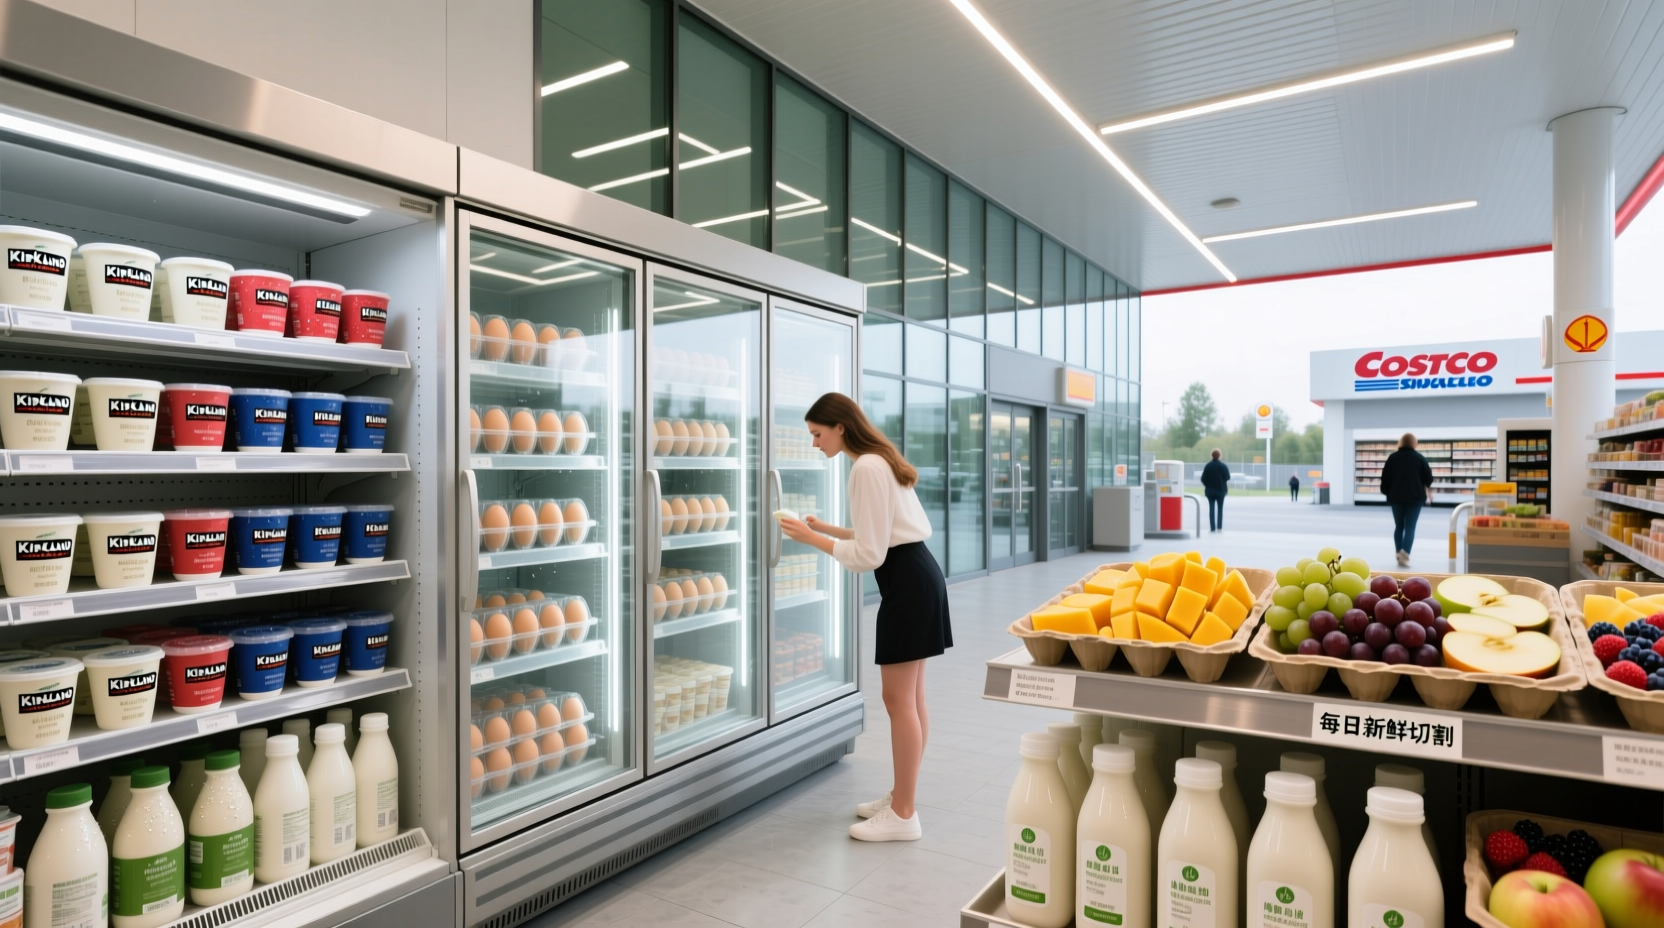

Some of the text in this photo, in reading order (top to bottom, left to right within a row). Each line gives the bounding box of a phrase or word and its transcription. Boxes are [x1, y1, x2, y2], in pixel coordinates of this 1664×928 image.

[1354, 351, 1498, 378] COSTCO
[1319, 711, 1454, 748] 每日新鲜切割
